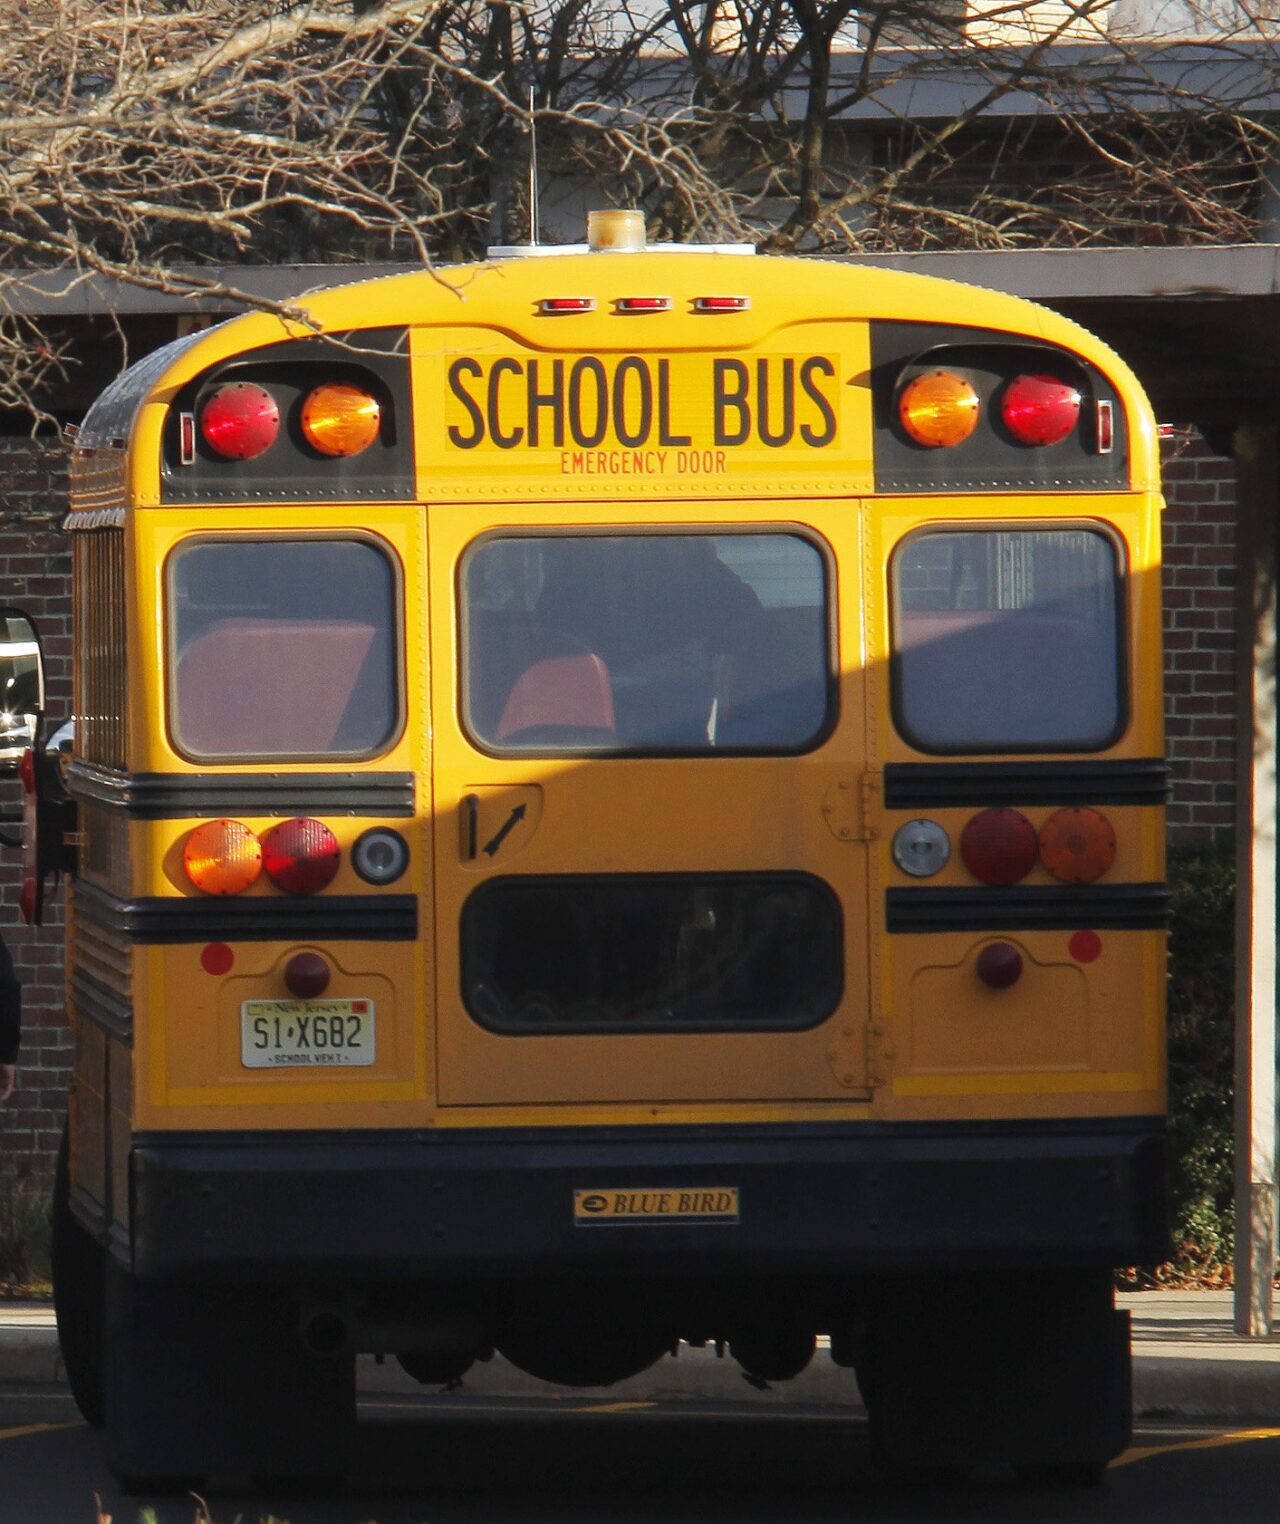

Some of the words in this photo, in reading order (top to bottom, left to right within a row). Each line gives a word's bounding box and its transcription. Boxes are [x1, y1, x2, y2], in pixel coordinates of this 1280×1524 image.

[447, 356, 692, 449] SCHOOL
[713, 356, 836, 448] BUS
[561, 451, 666, 474] EMERGENCY
[677, 450, 726, 473] DOOR
[274, 1054, 311, 1064] SCHOOL
[614, 1193, 672, 1214] BLUE
[677, 1192, 731, 1213] BIRD
